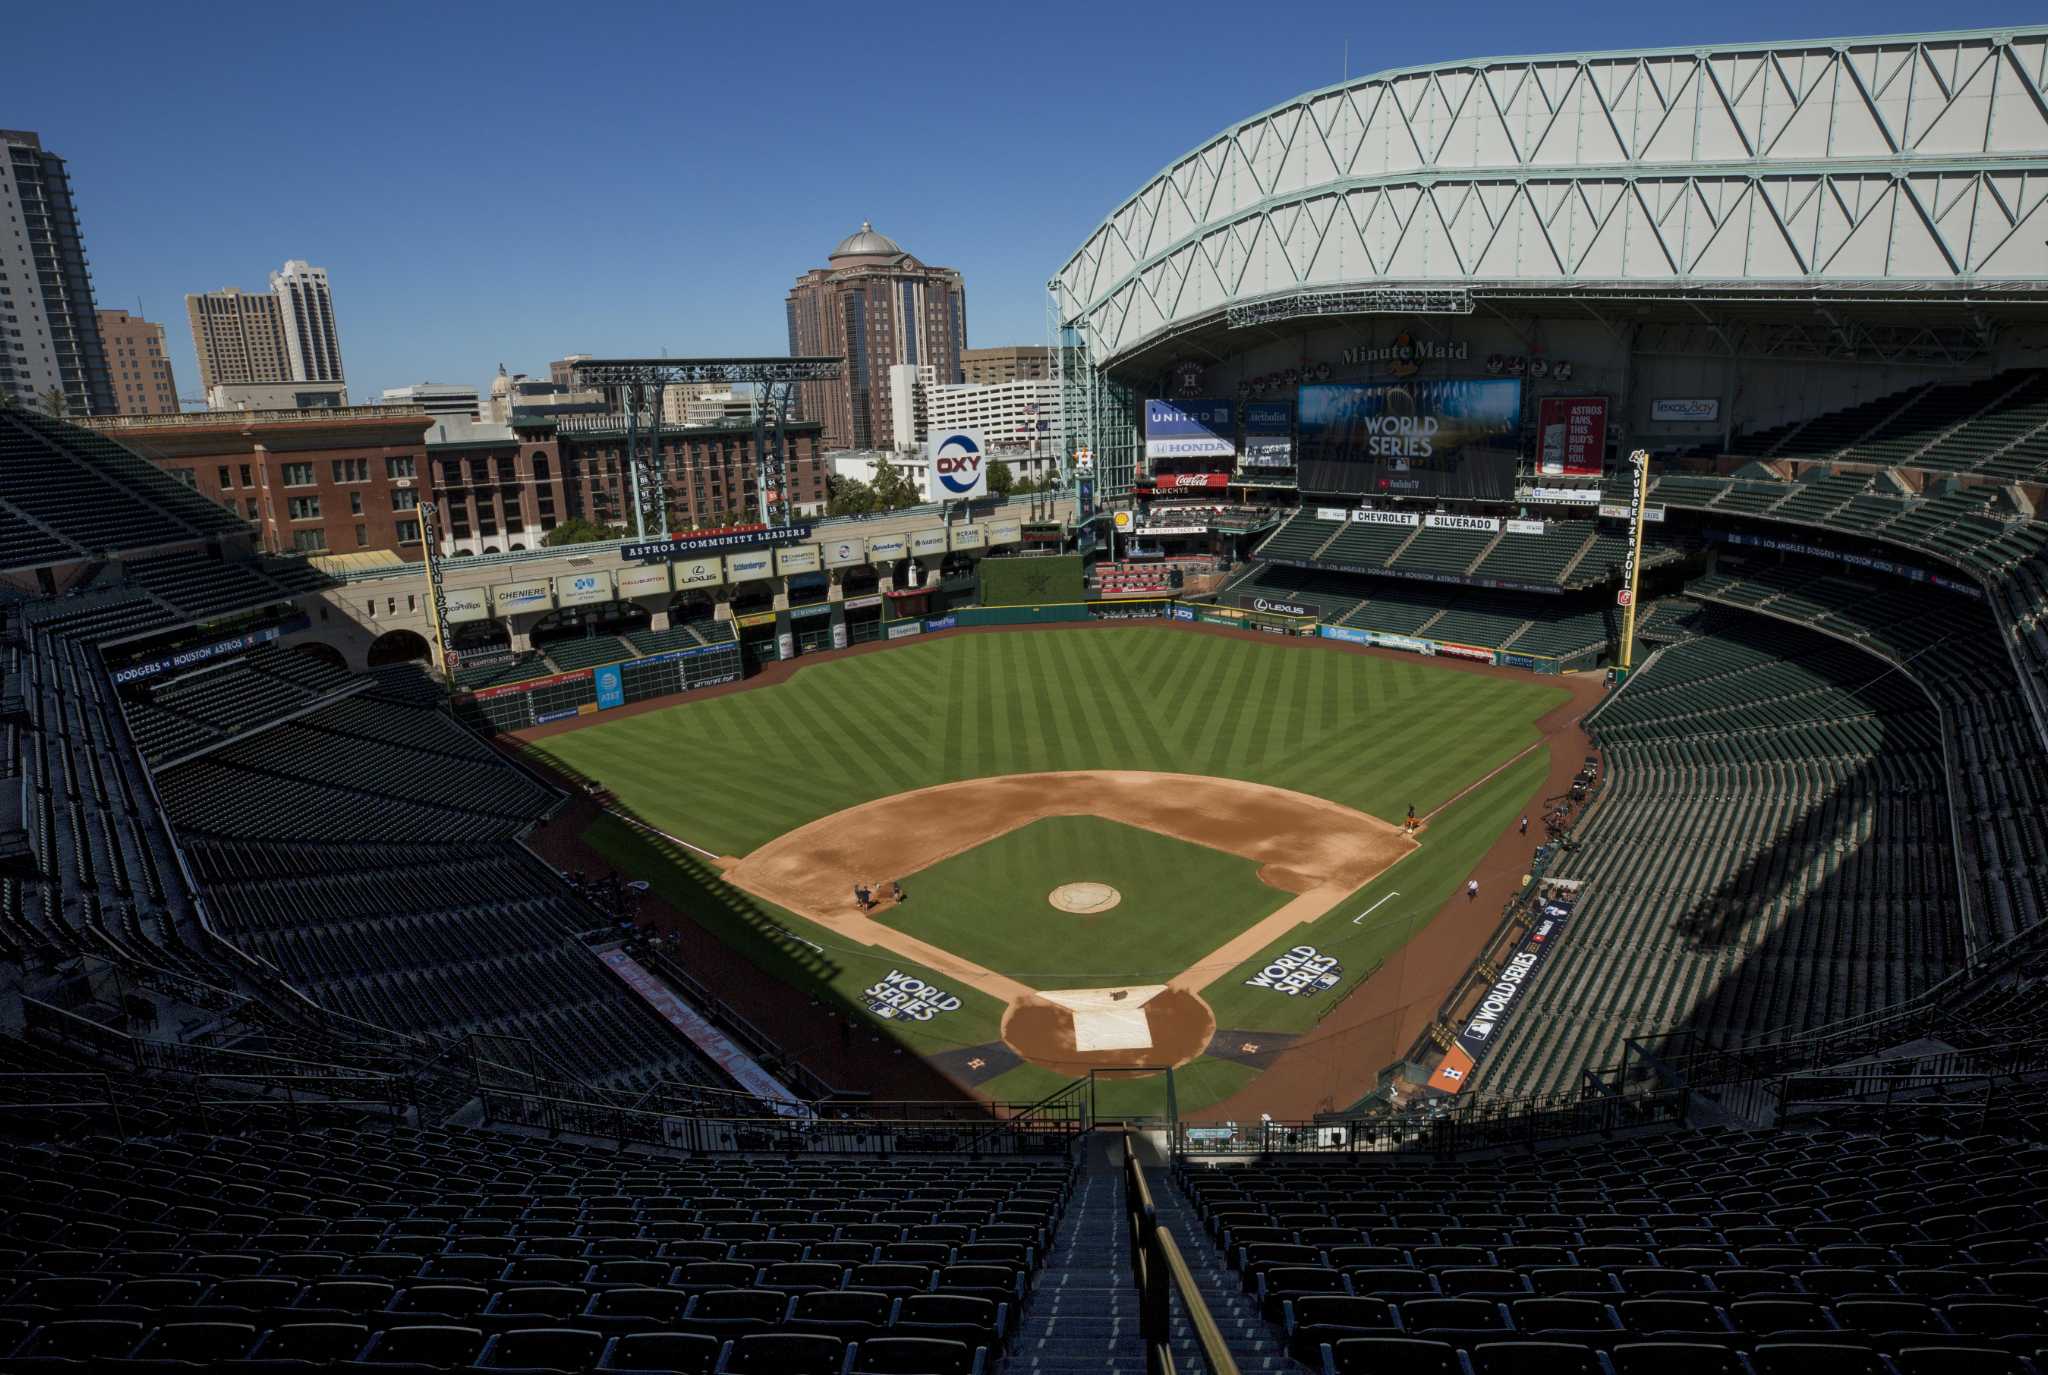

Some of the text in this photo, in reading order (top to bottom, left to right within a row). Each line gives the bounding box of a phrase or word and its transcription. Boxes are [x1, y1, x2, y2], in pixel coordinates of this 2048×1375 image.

[1342, 340, 1469, 365] Minute Maid
[1184, 374, 1197, 387] H
[1152, 412, 1211, 423] UNITED
[1570, 406, 1602, 415] ASTROS
[1365, 416, 1439, 436] WORLD
[1570, 416, 1593, 425] FANS,
[1570, 425, 1588, 434] THIS
[1369, 436, 1432, 457] SERIES
[1569, 435, 1594, 444] BUD'S
[1169, 443, 1225, 453] HONDA
[1569, 444, 1584, 453] FOR
[937, 456, 981, 473] OXY
[1568, 454, 1587, 463] YOU.
[1176, 474, 1209, 487] Coca-Cola
[1628, 469, 1642, 534] BURGERZ
[1358, 511, 1413, 525] CHEVROLET
[1434, 516, 1492, 530] SILVERADO
[629, 528, 806, 556] ASTROS COMMUNITY LEADERS
[1628, 537, 1636, 548] R
[682, 574, 717, 584] LEXUS
[499, 587, 546, 601] CHENIERE
[1269, 603, 1305, 614] LEXUS
[117, 662, 161, 682] DODGERS
[174, 647, 211, 666] HOUSTON
[214, 639, 242, 654] ASTROS
[600, 691, 620, 702] AT&T
[1245, 945, 1317, 987] WORLD
[1274, 955, 1338, 995] SERIES
[884, 969, 963, 1011] WORLD
[1476, 982, 1517, 1023] WORLD
[1502, 952, 1537, 985] SERIES
[865, 982, 940, 1020] SERIES
[1443, 1067, 1464, 1081] H
